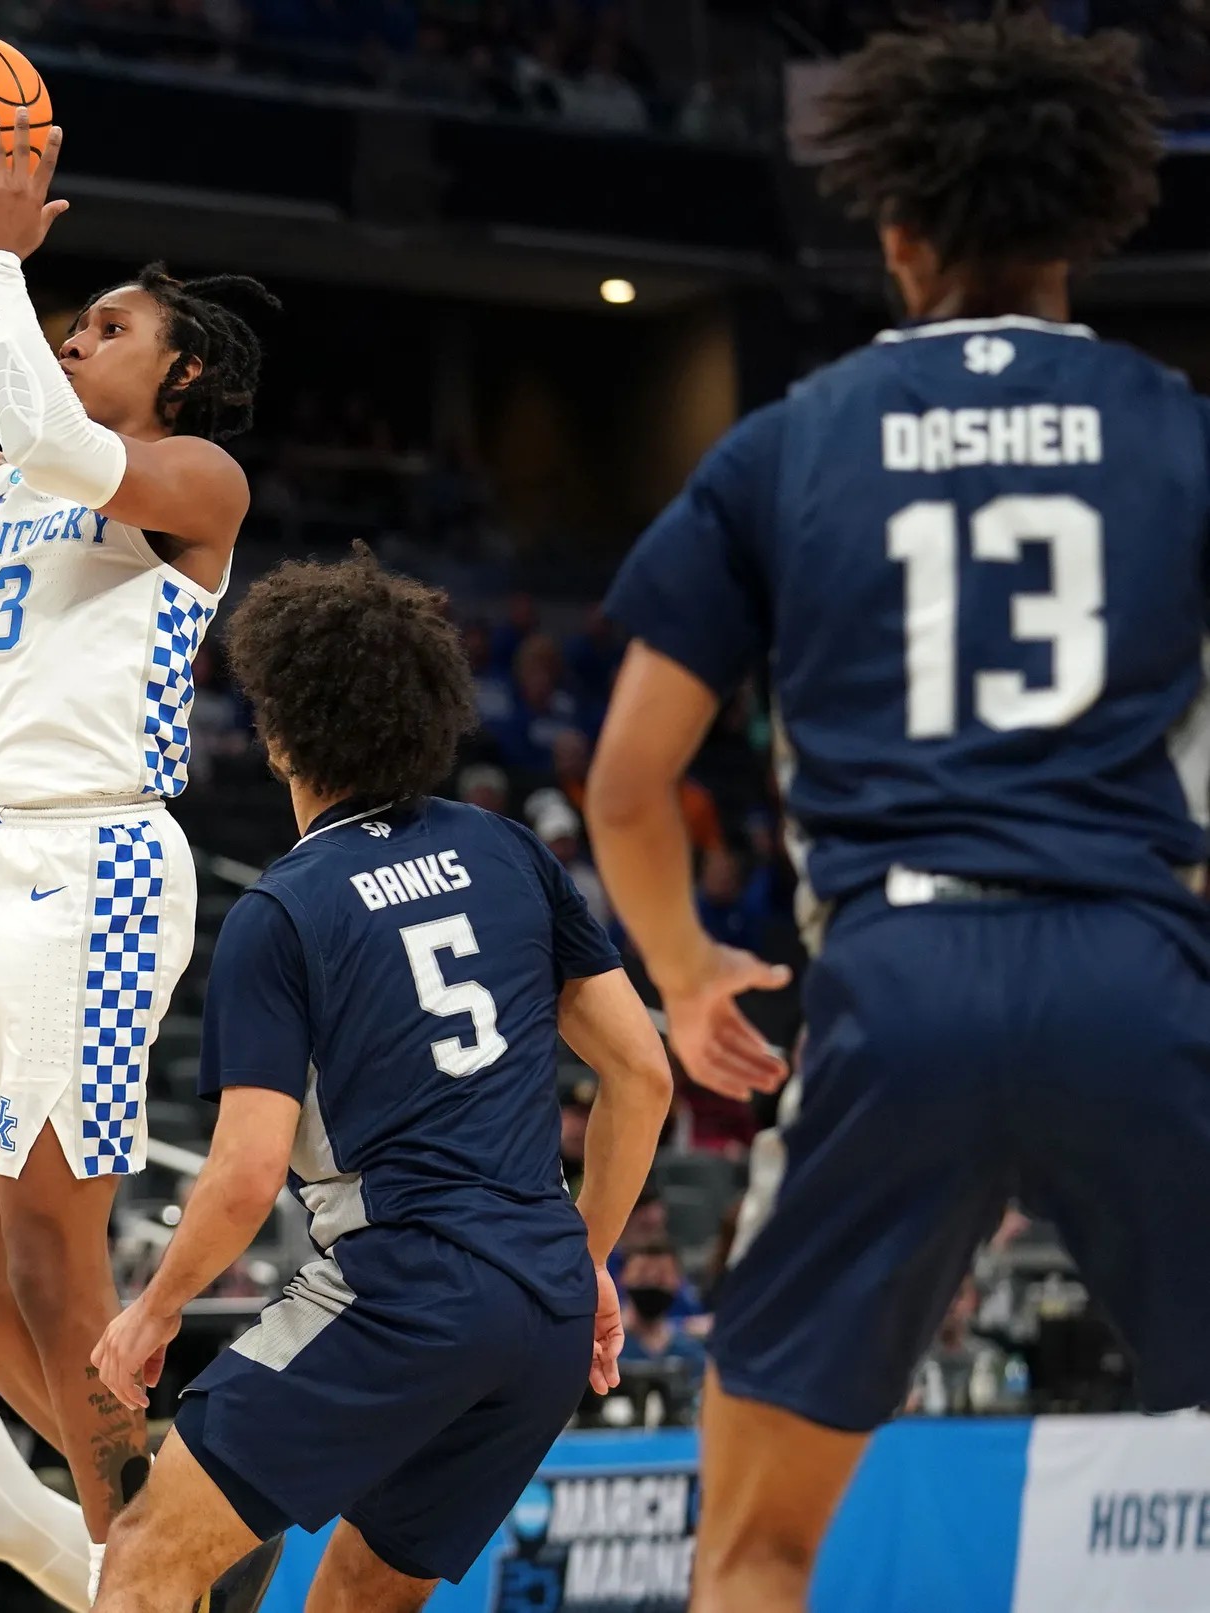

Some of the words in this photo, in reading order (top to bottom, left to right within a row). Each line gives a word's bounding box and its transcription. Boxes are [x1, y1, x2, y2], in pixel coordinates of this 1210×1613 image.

[882, 403, 1103, 473] DASHER
[886, 495, 1107, 740] 13
[349, 849, 472, 911] BANKS
[398, 912, 509, 1079] 5
[547, 1474, 688, 1542] MARCH
[564, 1537, 696, 1602] MADN
